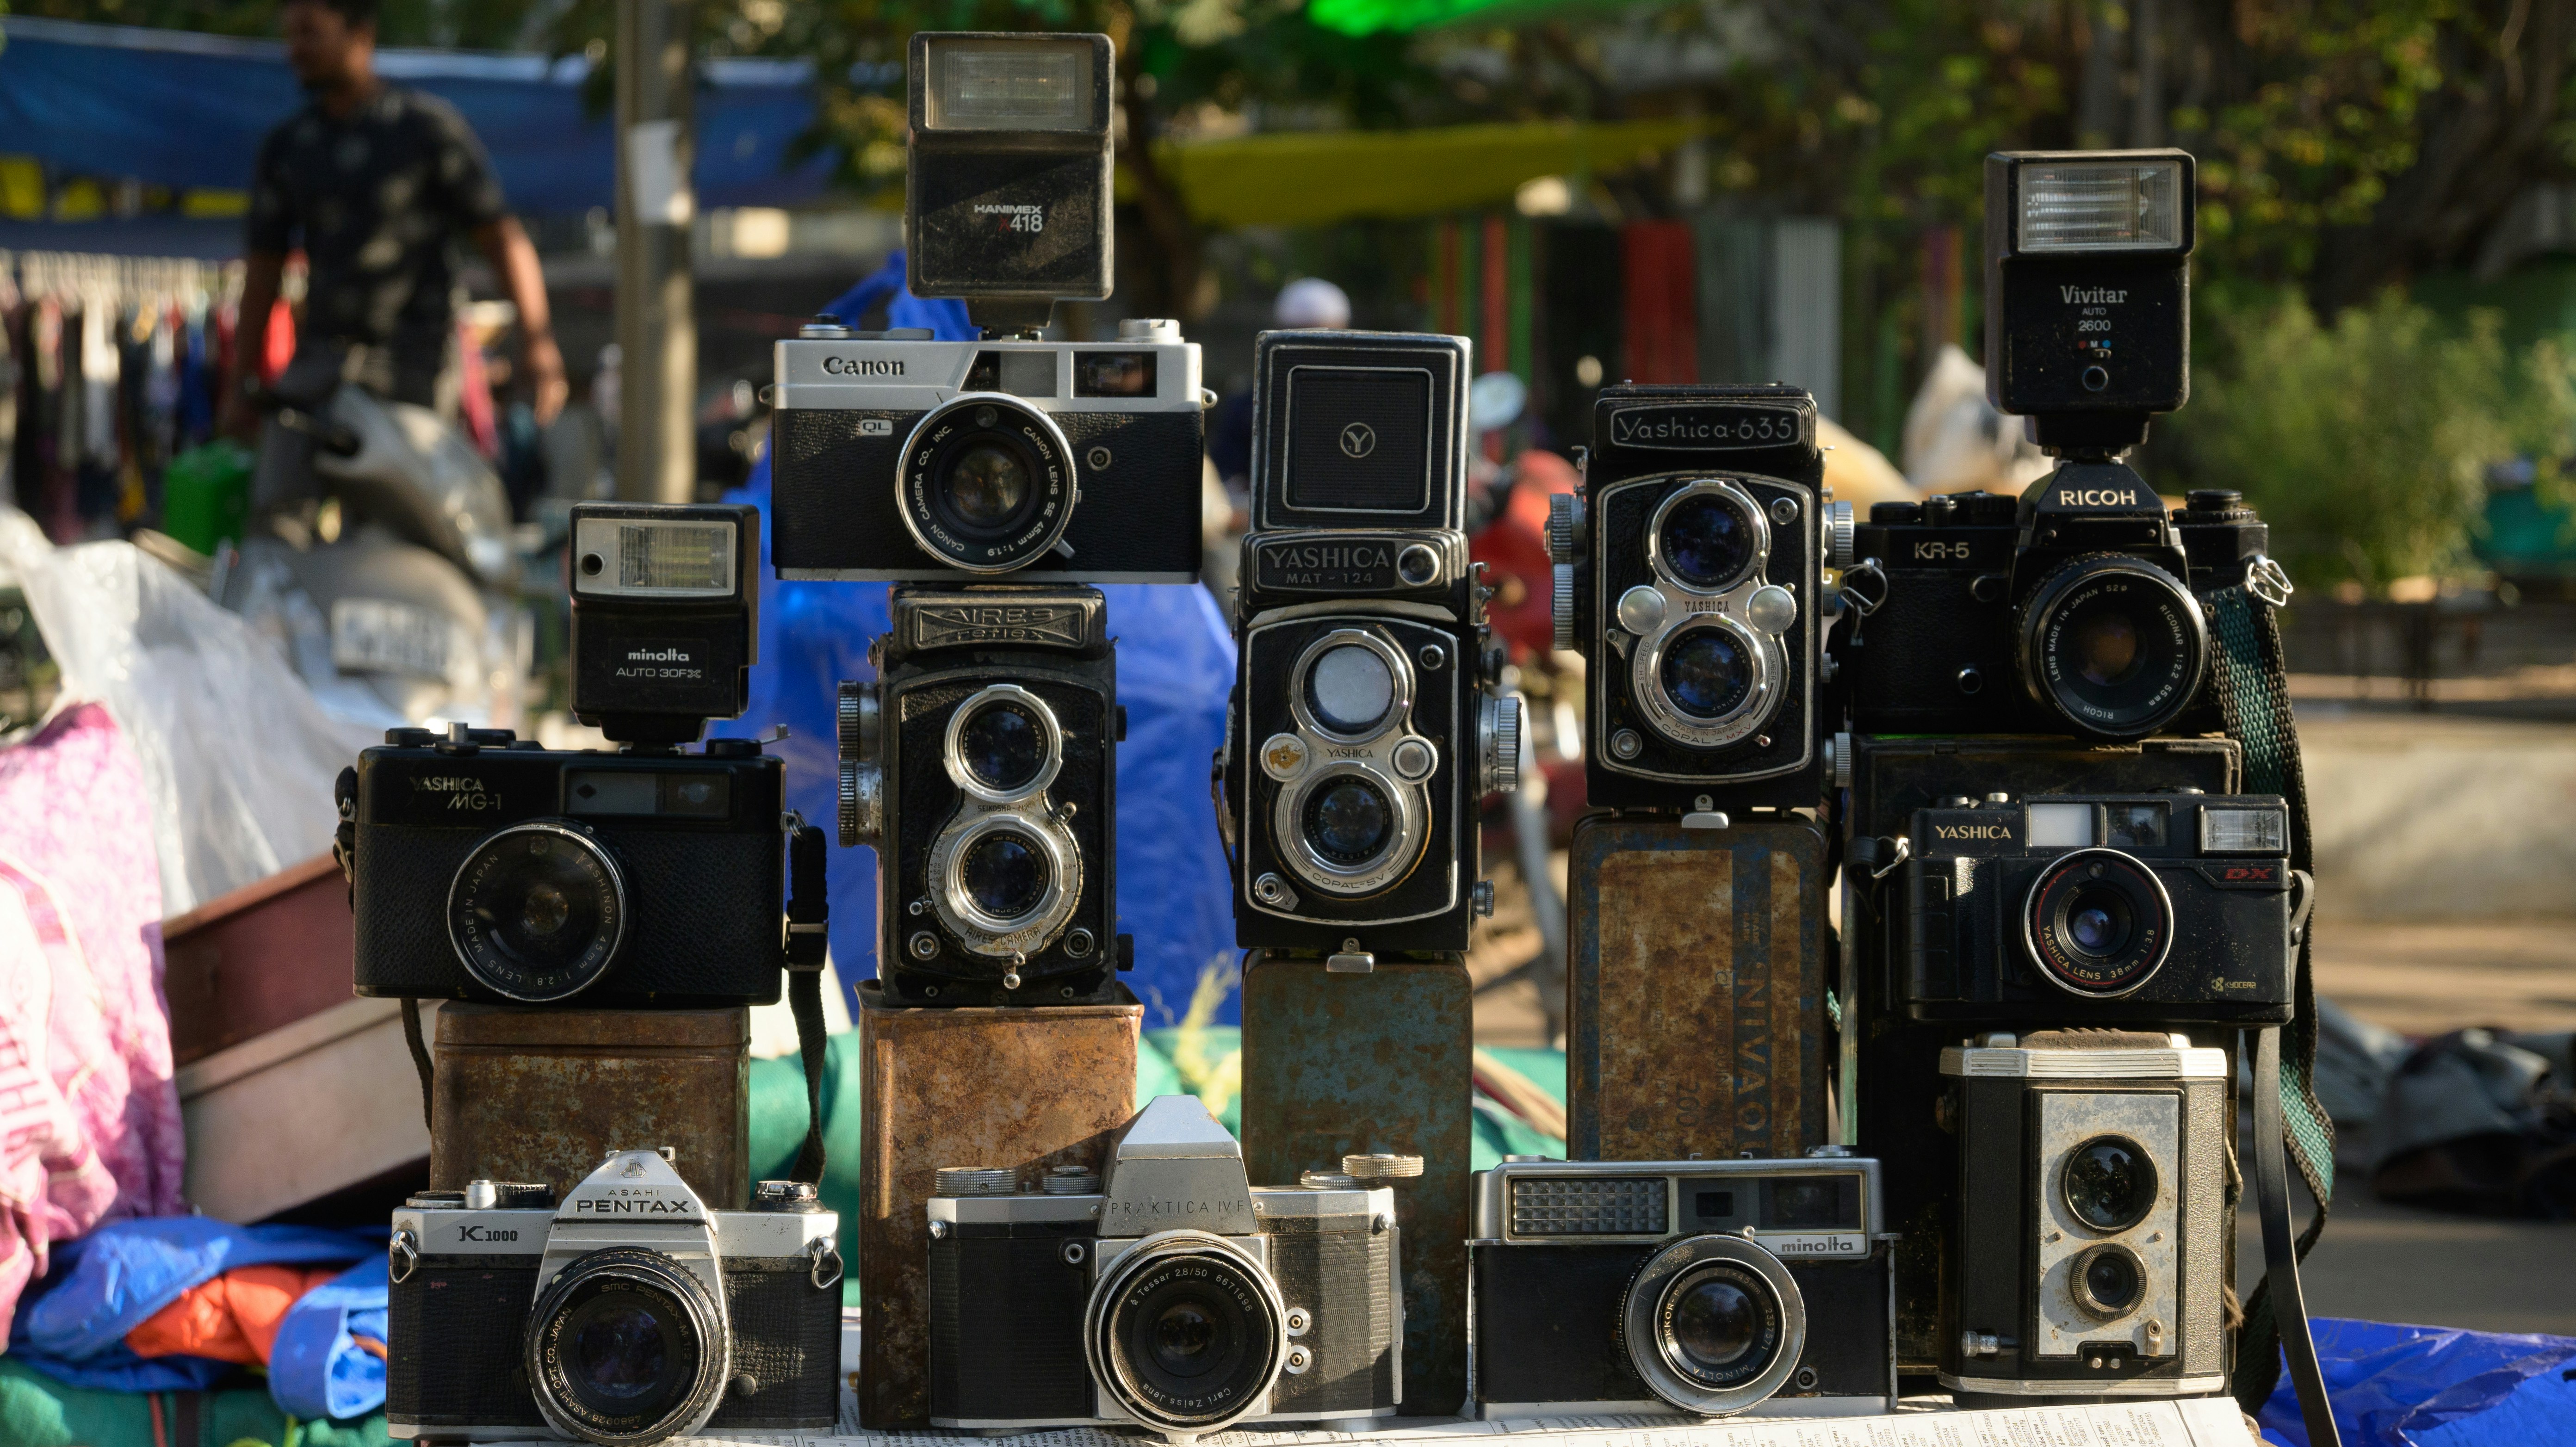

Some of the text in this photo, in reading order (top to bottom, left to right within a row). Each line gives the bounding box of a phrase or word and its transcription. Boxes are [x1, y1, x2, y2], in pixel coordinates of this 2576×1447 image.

[974, 204, 1042, 214] HANIMEX
[998, 214, 1043, 232] X418
[2060, 285, 2128, 304] Vivitar
[2082, 308, 2107, 316] AUTO
[2078, 320, 2111, 332] 2600
[2090, 340, 2099, 348] M
[823, 356, 905, 376] Canon
[862, 421, 890, 433] QL
[932, 425, 954, 443] INC.
[1618, 416, 1793, 443] Yashica-635
[1346, 431, 1370, 453] Y
[915, 473, 930, 520] CAMERA
[987, 426, 1058, 557] CANON LENS SE 45mm 1:1.9
[2060, 489, 2137, 507] RICOH
[930, 524, 965, 551] CANON
[1265, 547, 1390, 569] YASHICA
[1913, 542, 1970, 559] KR-5
[1286, 572, 1374, 585] MAT 124
[1684, 600, 1730, 613] YASHICA
[2071, 587, 2099, 609] JAPAN
[948, 608, 1053, 624] AIRES
[2059, 610, 2070, 621] IN
[2048, 625, 2061, 653] MADE
[627, 648, 690, 662] minolta
[1639, 641, 1650, 681] SH-SPEED
[1765, 641, 1777, 681] F-NUMBER
[2148, 604, 2184, 706] RICONAR 1:2.2 55mm
[616, 668, 701, 679] AUTO 30FX
[2049, 655, 2061, 681] LENS
[2082, 705, 2114, 720] RICOH
[1675, 723, 1697, 736] MADE
[1711, 724, 1740, 736] JAPAN
[1326, 748, 1374, 758] YASHICA
[409, 776, 484, 793] YASHICA
[446, 792, 502, 810] MG-1
[1935, 825, 2012, 840] YASHICA
[1312, 873, 1385, 889] COPAL-SV
[2224, 867, 2273, 880] DX
[465, 854, 499, 953] MADE IN JAPAN
[488, 852, 613, 986] YASHINON 45mm 1:2.8 LENS
[965, 925, 1041, 946] AIRES CAMERA
[2043, 925, 2070, 969] YASHICA
[2073, 966, 2101, 980] LENS
[2110, 959, 2139, 979] 38mm
[576, 1200, 688, 1213] PENTAX
[1111, 1200, 1210, 1215] PRAKTICA
[458, 1225, 518, 1243] K1000
[1781, 1236, 1854, 1254] minolta
[1137, 1272, 1170, 1296] Tessar
[1215, 1274, 1253, 1311] 6671696
[550, 1307, 573, 1342] JAPAN
[548, 1367, 562, 1389] OPT.
[559, 1390, 589, 1416] ASAHI
[1142, 1383, 1232, 1408] Carl Zeiss Jena
